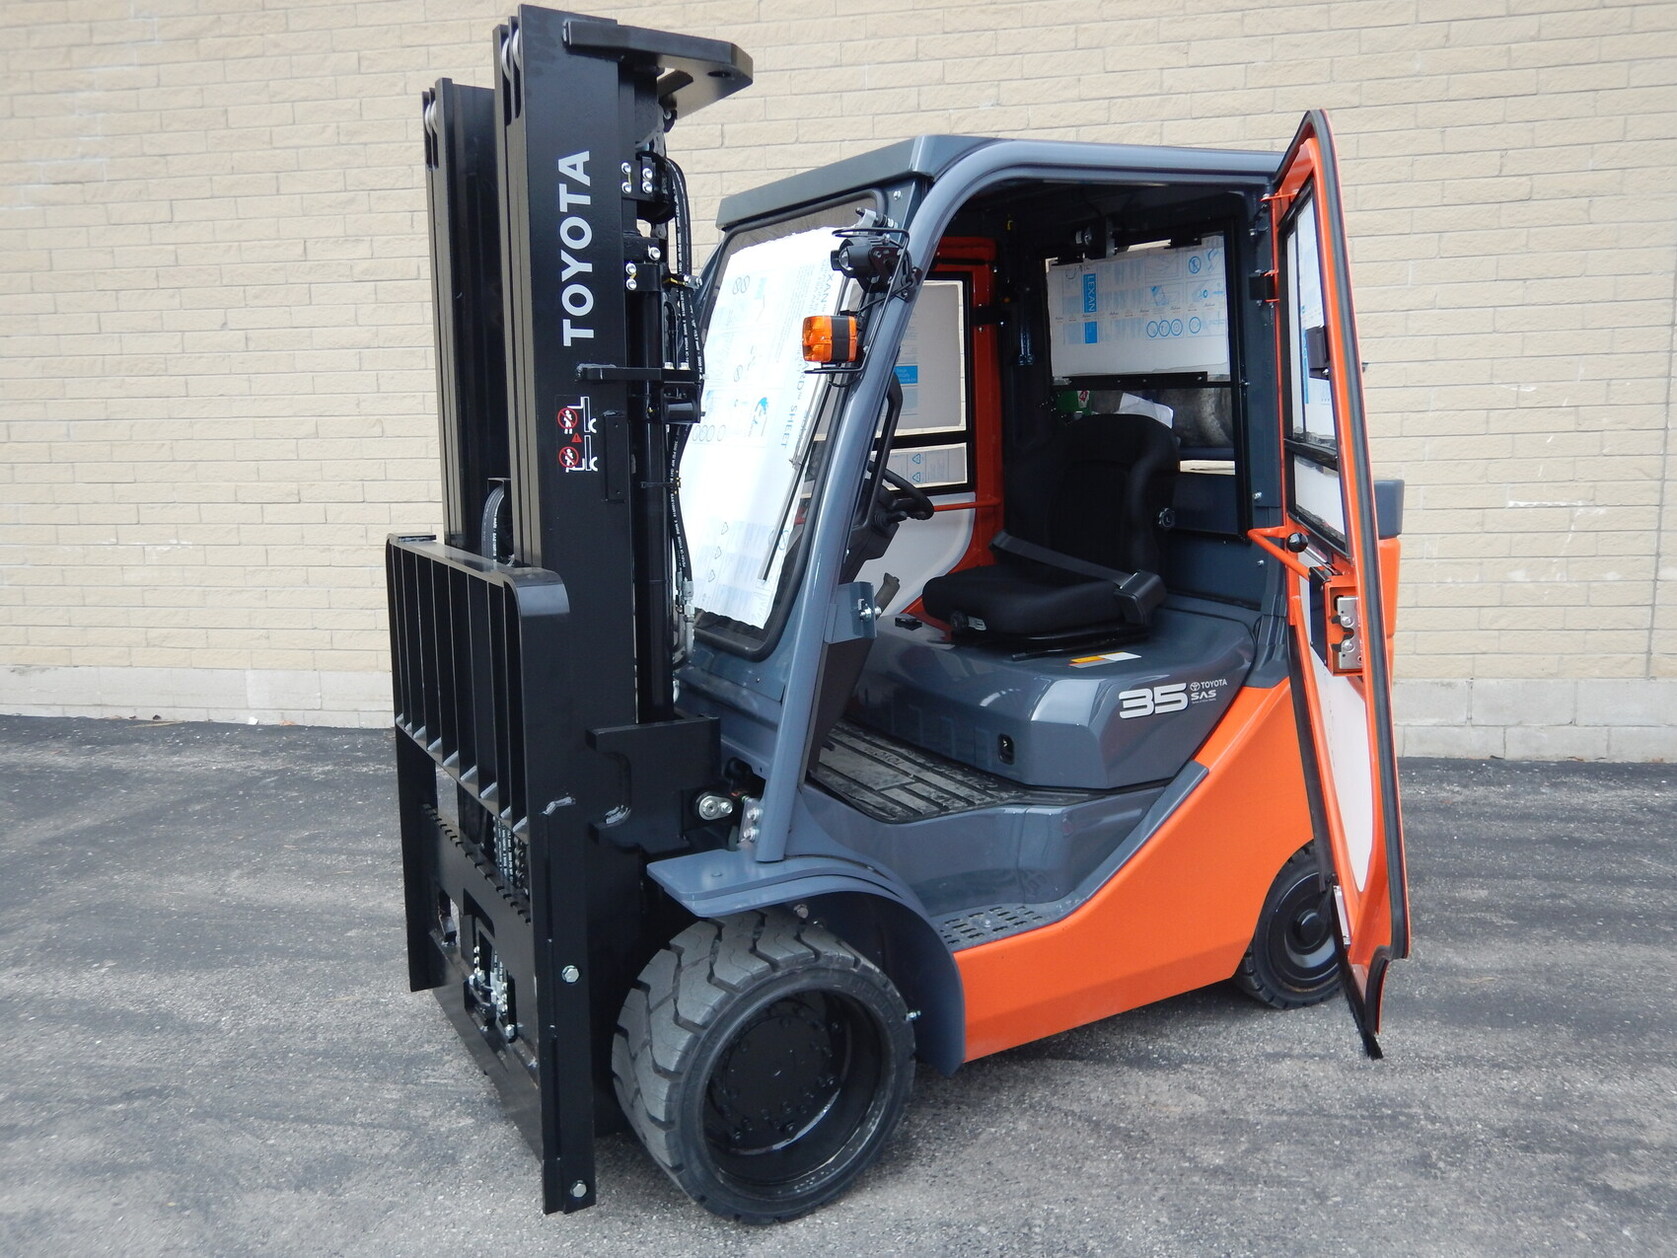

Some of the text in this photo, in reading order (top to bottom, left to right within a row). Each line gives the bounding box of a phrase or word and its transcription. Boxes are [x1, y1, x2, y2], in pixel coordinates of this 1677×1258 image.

[558, 151, 594, 346] TOYOTA
[1087, 275, 1095, 312] LEXAN
[1118, 682, 1189, 719] 35
[1190, 689, 1217, 701] SAS
[1200, 678, 1228, 689] TOYOTA
